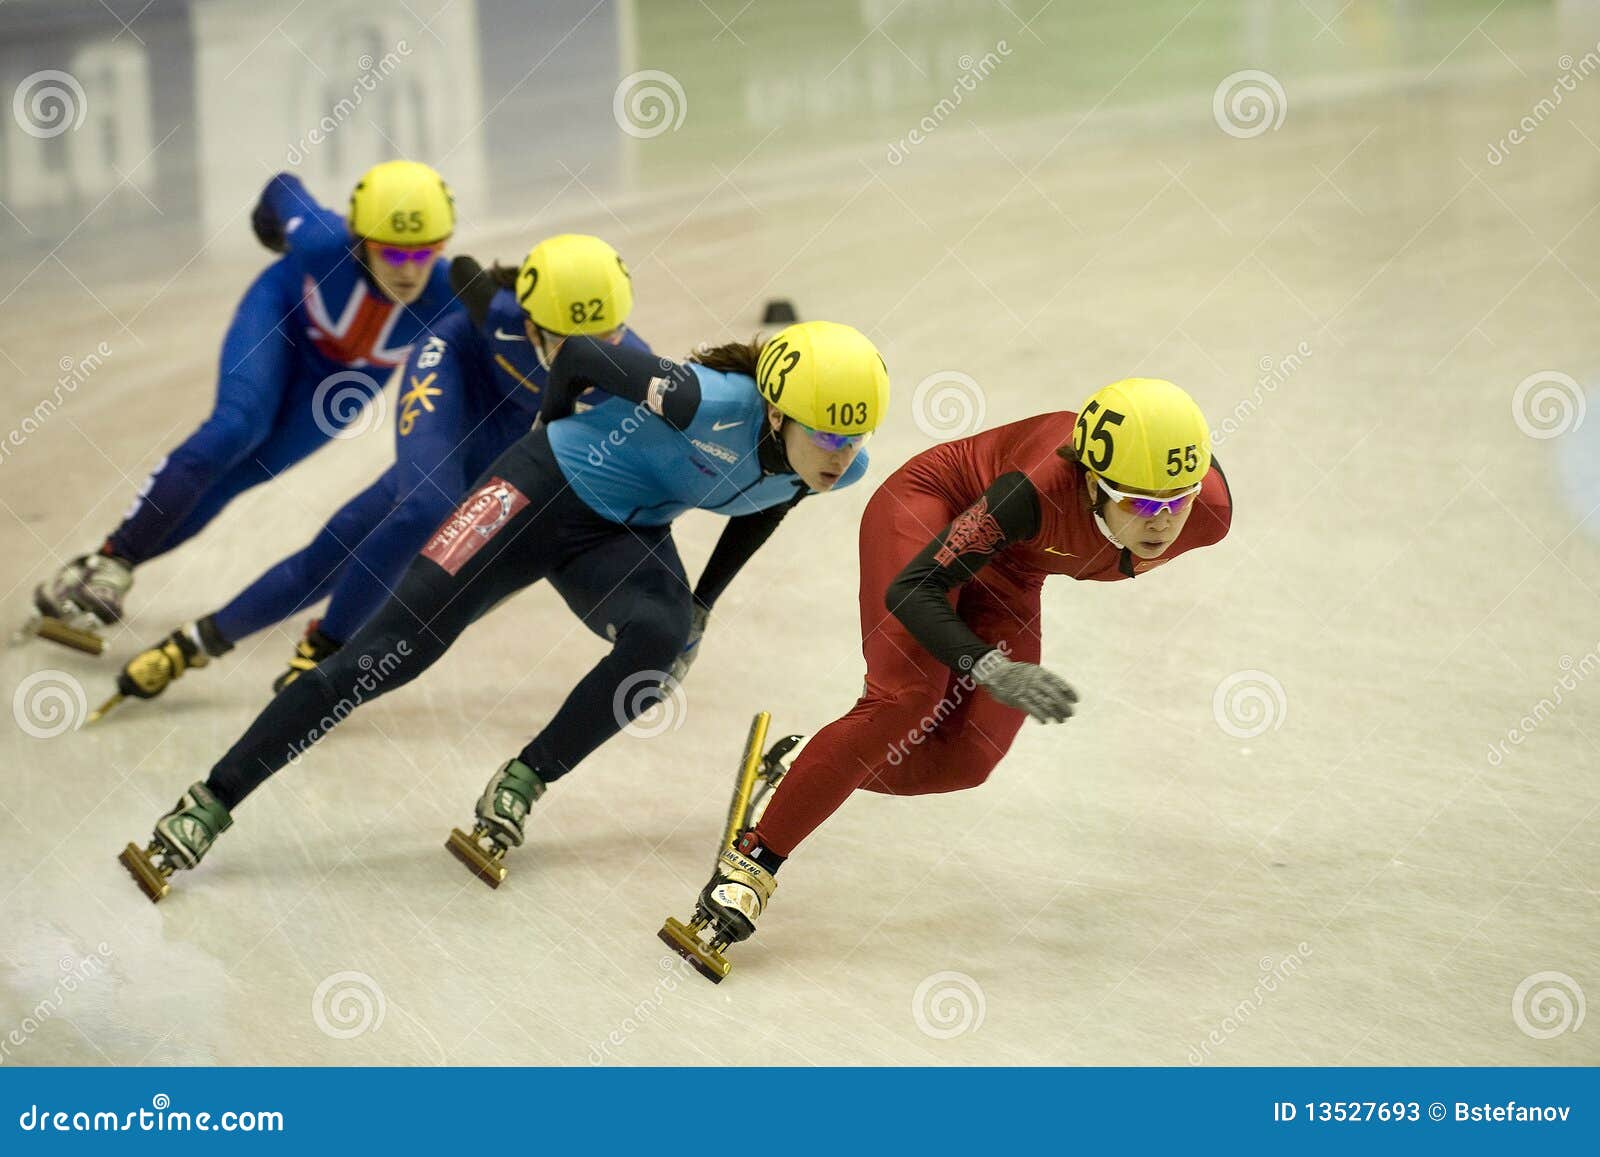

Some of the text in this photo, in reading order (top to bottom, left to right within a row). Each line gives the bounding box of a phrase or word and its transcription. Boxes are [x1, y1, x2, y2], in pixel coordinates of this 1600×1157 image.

[391, 211, 424, 233] 65
[570, 299, 605, 324] 82
[758, 336, 801, 404] 03
[826, 402, 867, 426] 103
[1074, 400, 1125, 472] 55
[1166, 445, 1197, 476] 55
